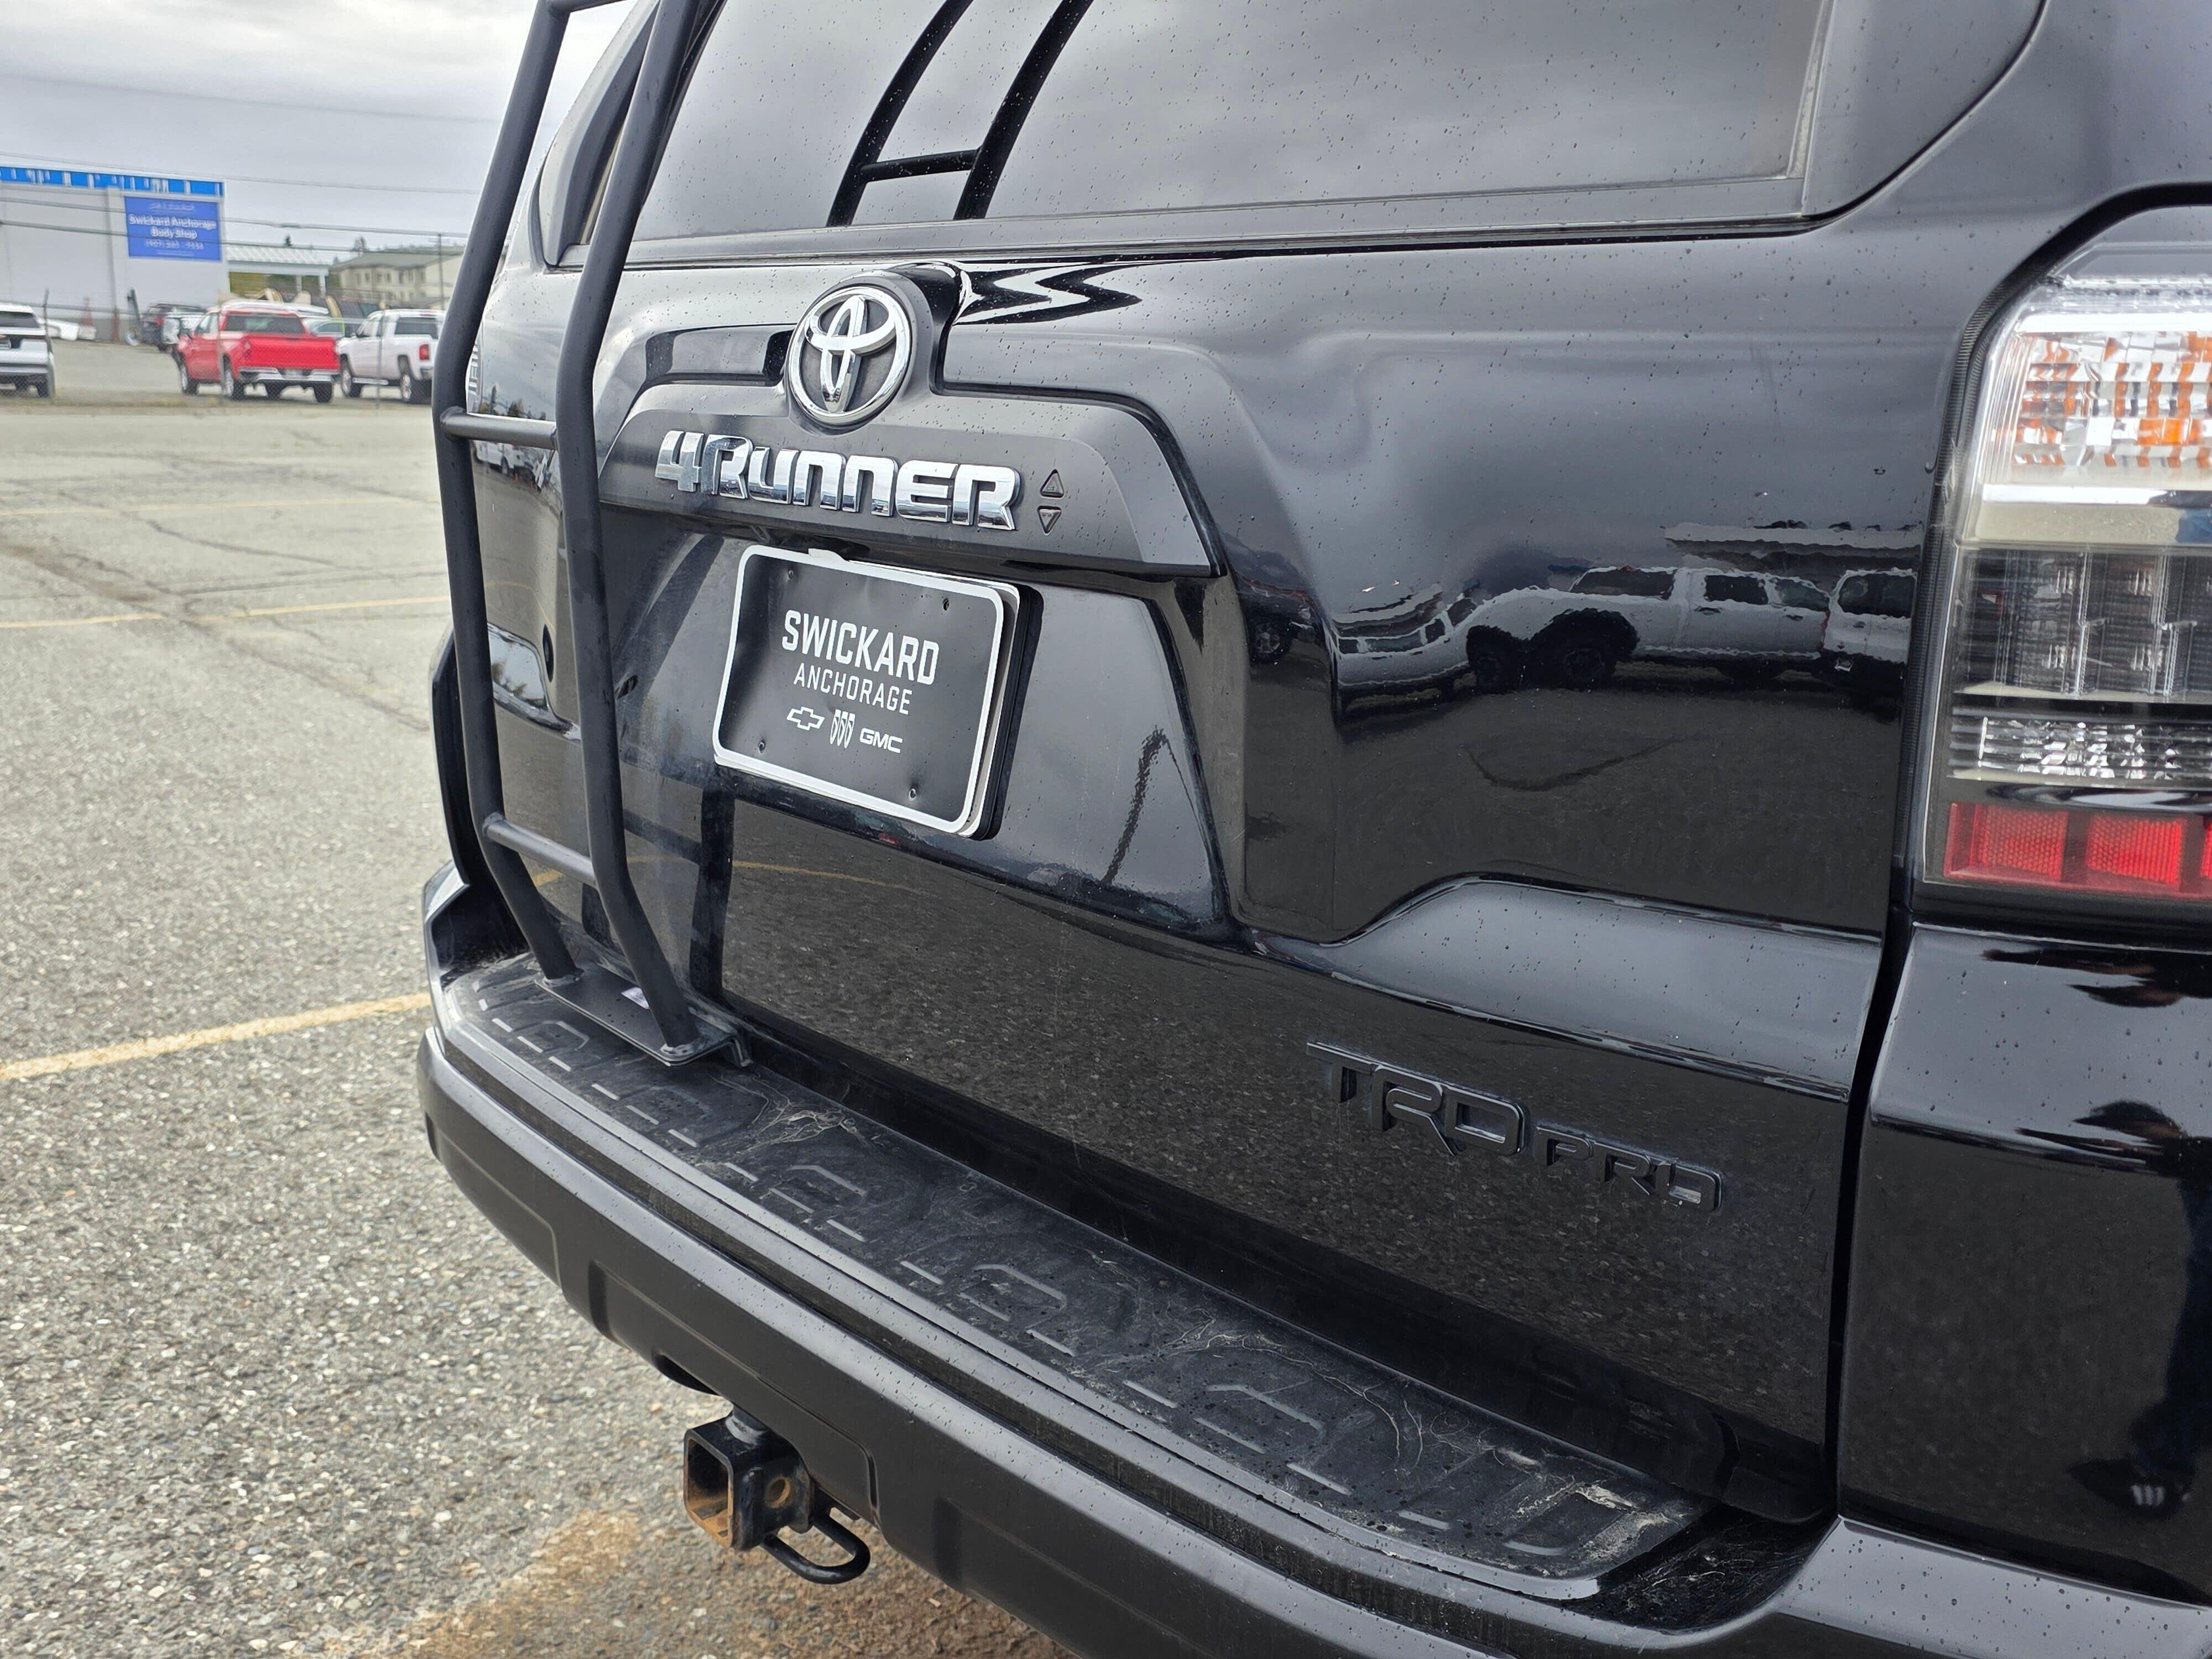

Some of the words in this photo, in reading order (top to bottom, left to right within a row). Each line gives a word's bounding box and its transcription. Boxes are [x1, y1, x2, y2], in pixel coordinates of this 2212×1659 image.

[782, 609, 940, 685] SWICKARD
[794, 662, 912, 715] ANCHORAGE
[859, 727, 903, 753] GMC
[1306, 1041, 1527, 1157] TRD
[1536, 1123, 1723, 1212] PRO
